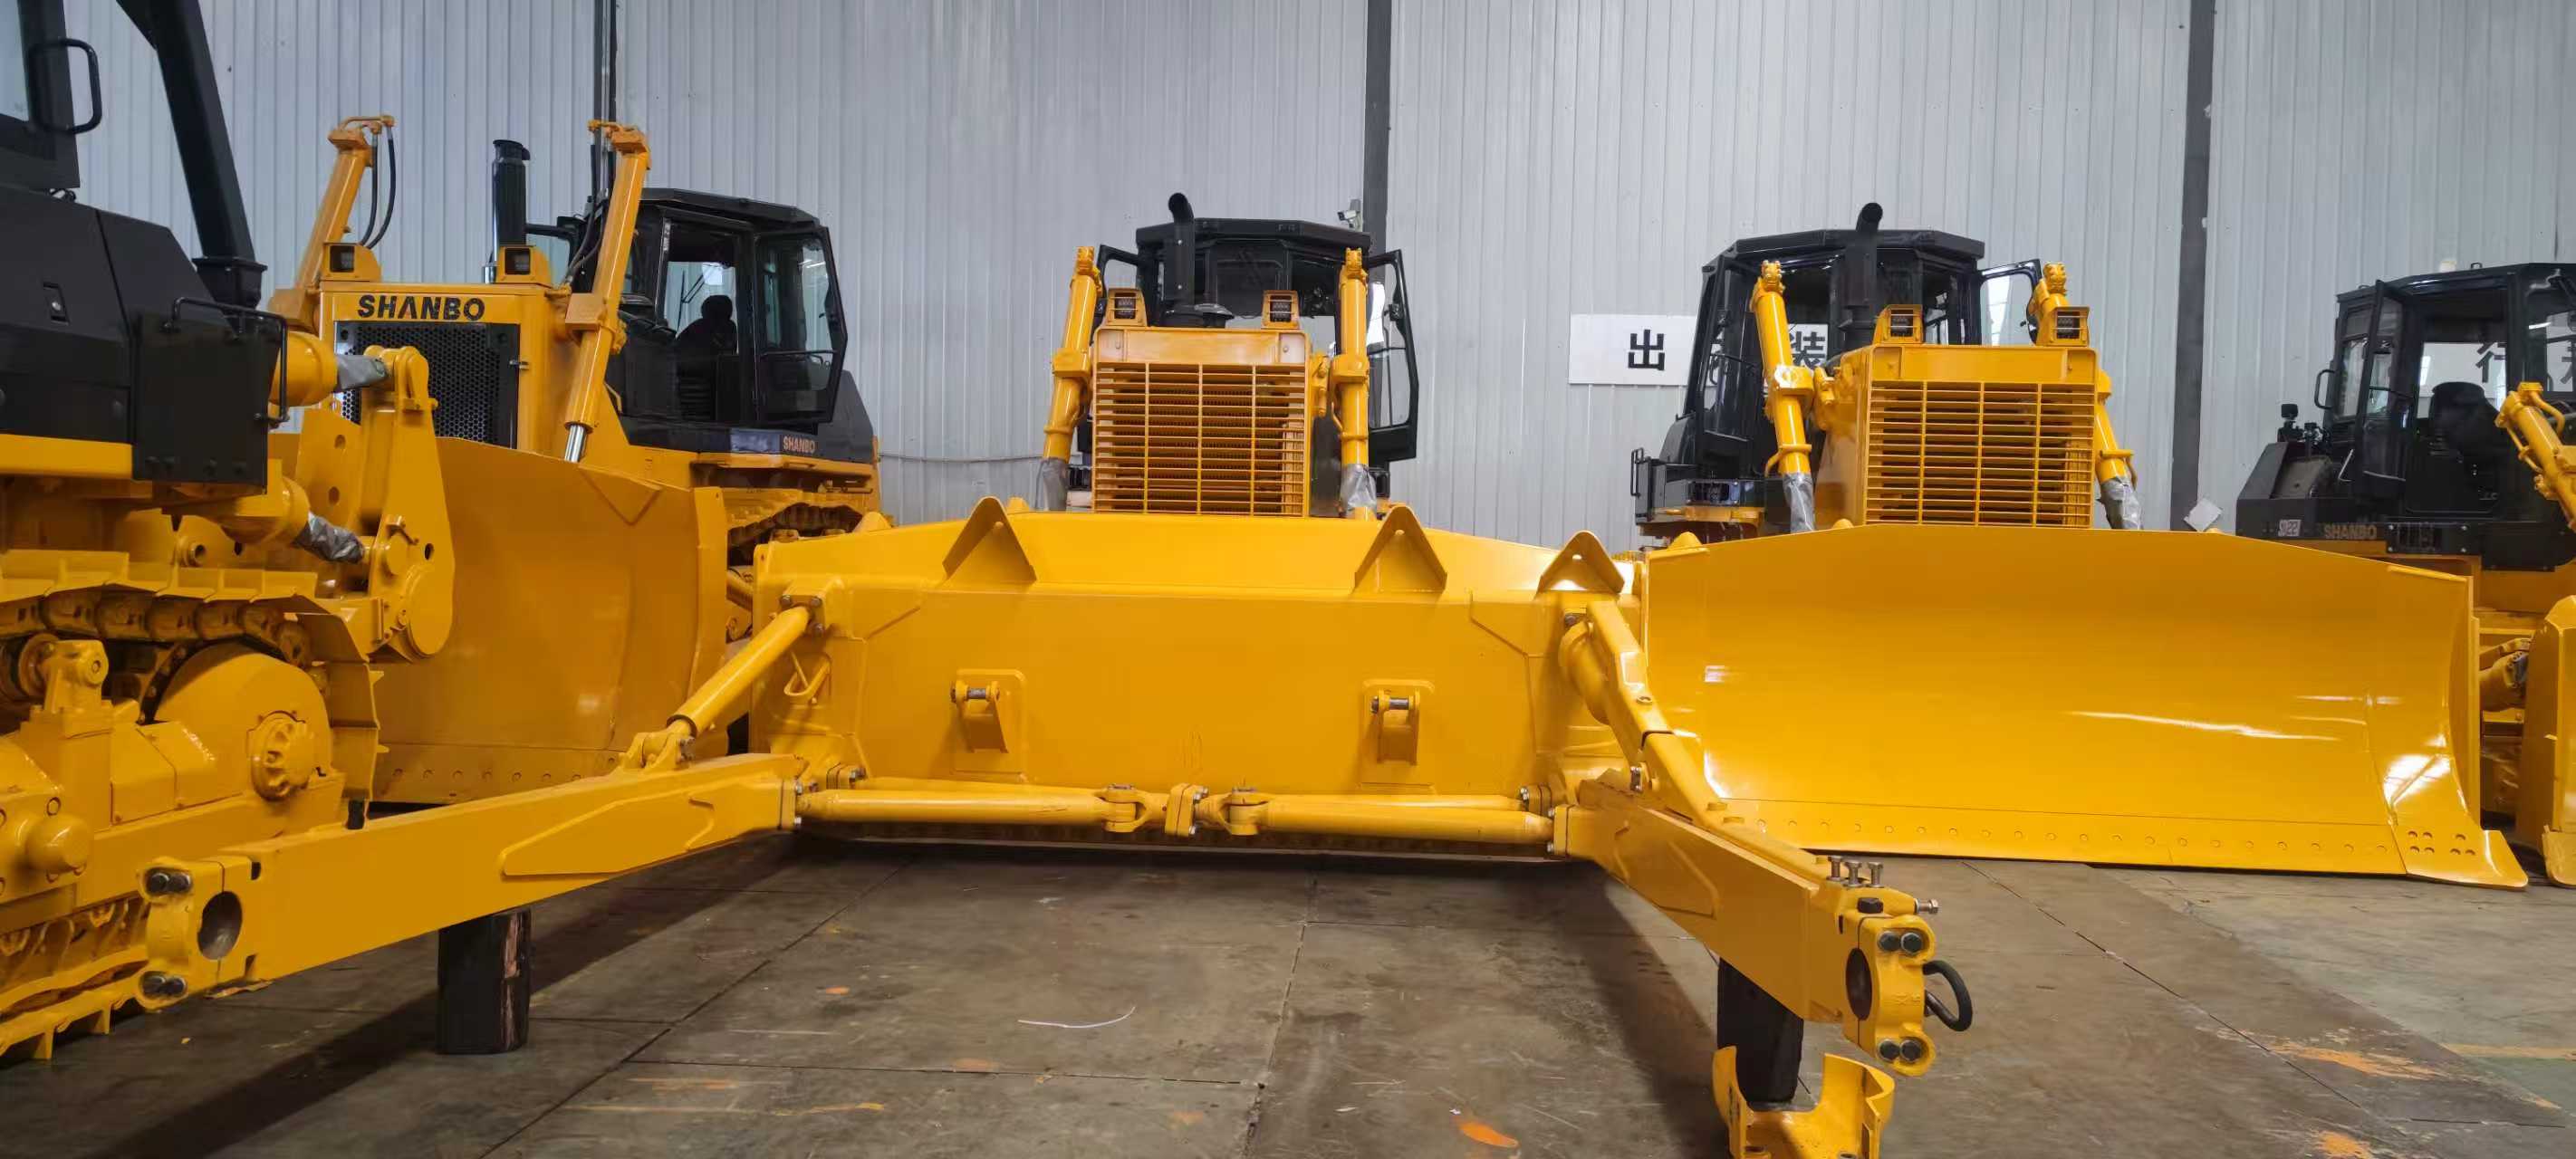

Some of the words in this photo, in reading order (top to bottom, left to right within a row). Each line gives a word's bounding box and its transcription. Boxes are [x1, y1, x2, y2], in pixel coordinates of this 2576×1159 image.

[358, 294, 485, 321] SHANBO
[1628, 329, 1665, 370] 出
[2323, 523, 2378, 540] SHANBO
